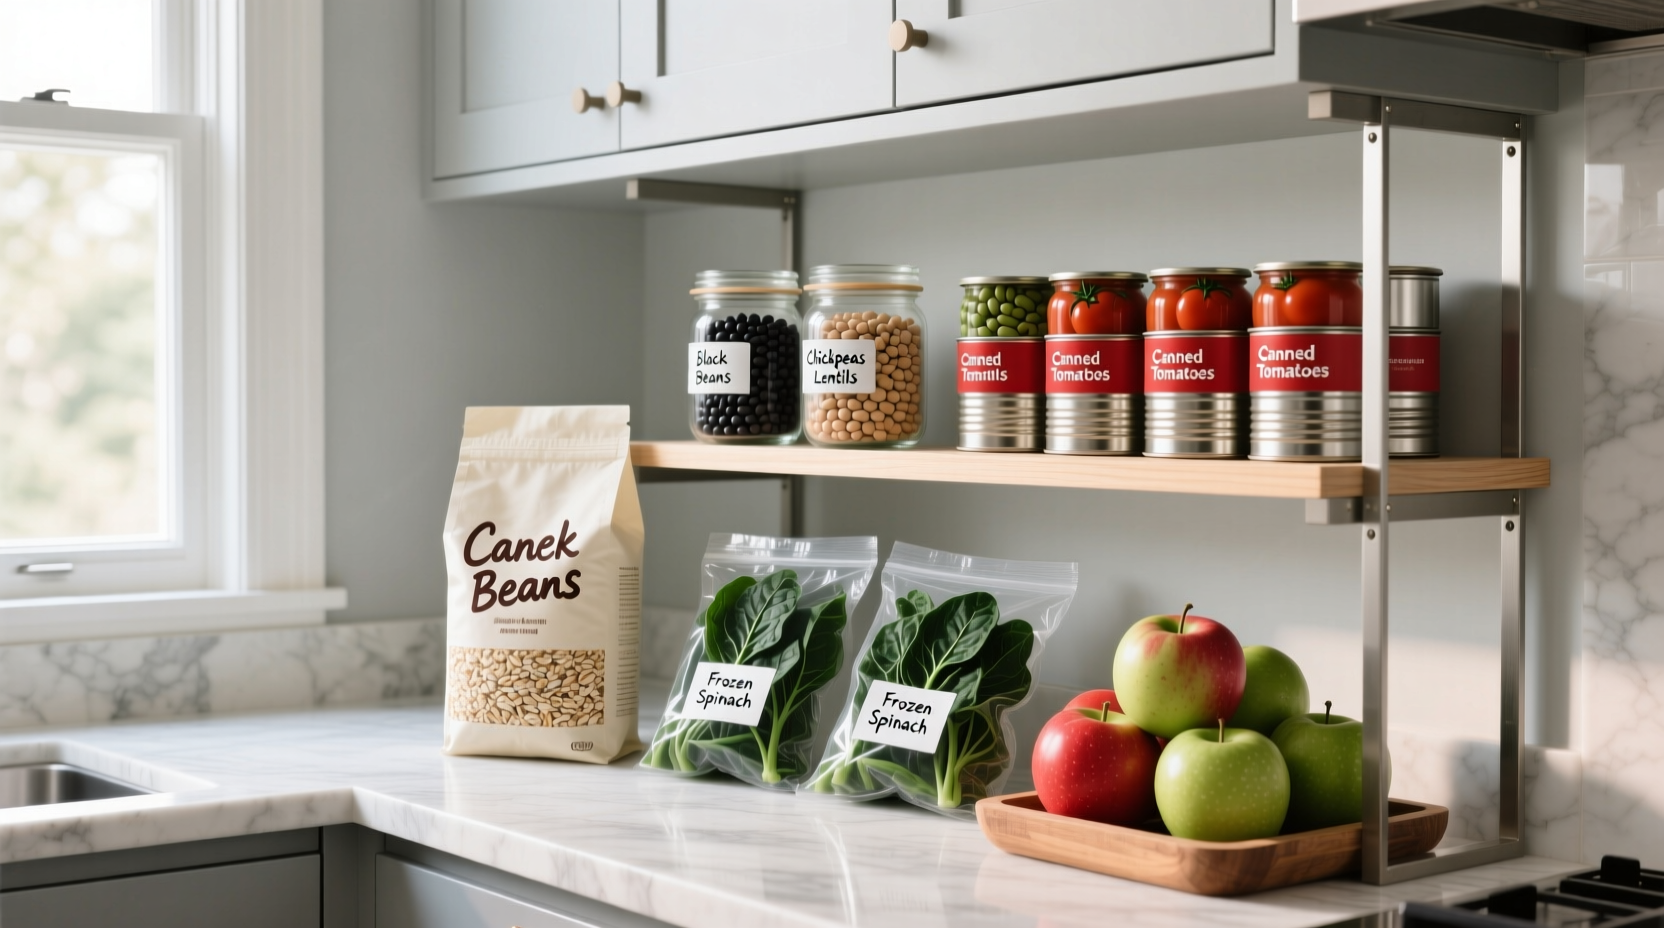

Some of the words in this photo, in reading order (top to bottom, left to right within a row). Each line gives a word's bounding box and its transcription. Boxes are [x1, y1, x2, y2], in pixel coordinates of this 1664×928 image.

[696, 349, 728, 367] Black
[806, 348, 866, 369] Chickpeas
[1151, 348, 1203, 365] Canned
[1257, 344, 1316, 362] Canned
[695, 370, 732, 385] Beans
[814, 369, 858, 385] Lentils
[1150, 365, 1215, 381] Tomatoes
[1256, 363, 1330, 379] Tomatoes
[463, 519, 580, 567] Canek
[471, 569, 582, 614] Beans
[707, 671, 753, 690] Frozen
[696, 689, 752, 710] Spinach
[882, 692, 932, 715] Frozen
[868, 709, 928, 735] Spinach
